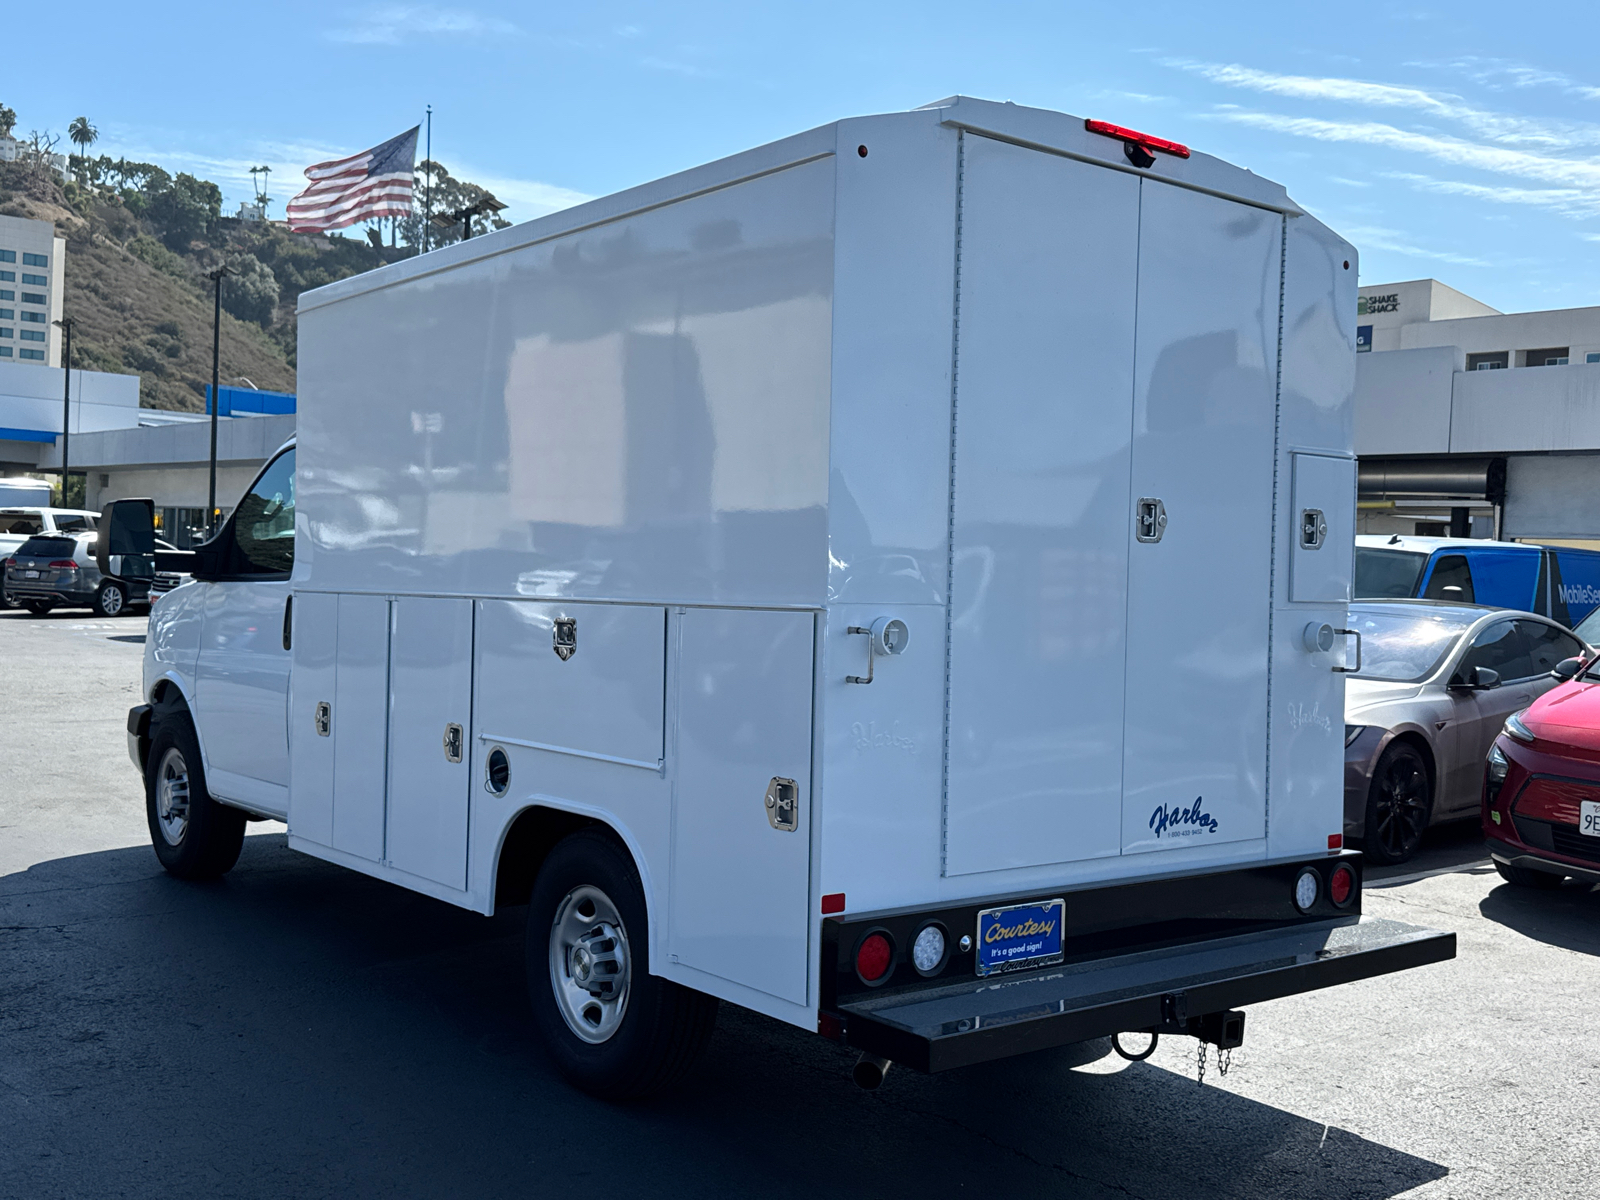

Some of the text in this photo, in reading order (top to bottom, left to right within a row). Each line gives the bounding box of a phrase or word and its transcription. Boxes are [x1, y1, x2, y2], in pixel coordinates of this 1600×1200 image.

[1369, 294, 1398, 305] SHAKE
[1367, 303, 1398, 314] SHACK
[1149, 796, 1218, 838] Harbor
[985, 918, 1056, 943] Courtesy
[991, 949, 1002, 957] It's
[1008, 943, 1025, 956] good
[1026, 941, 1042, 953] sign!
